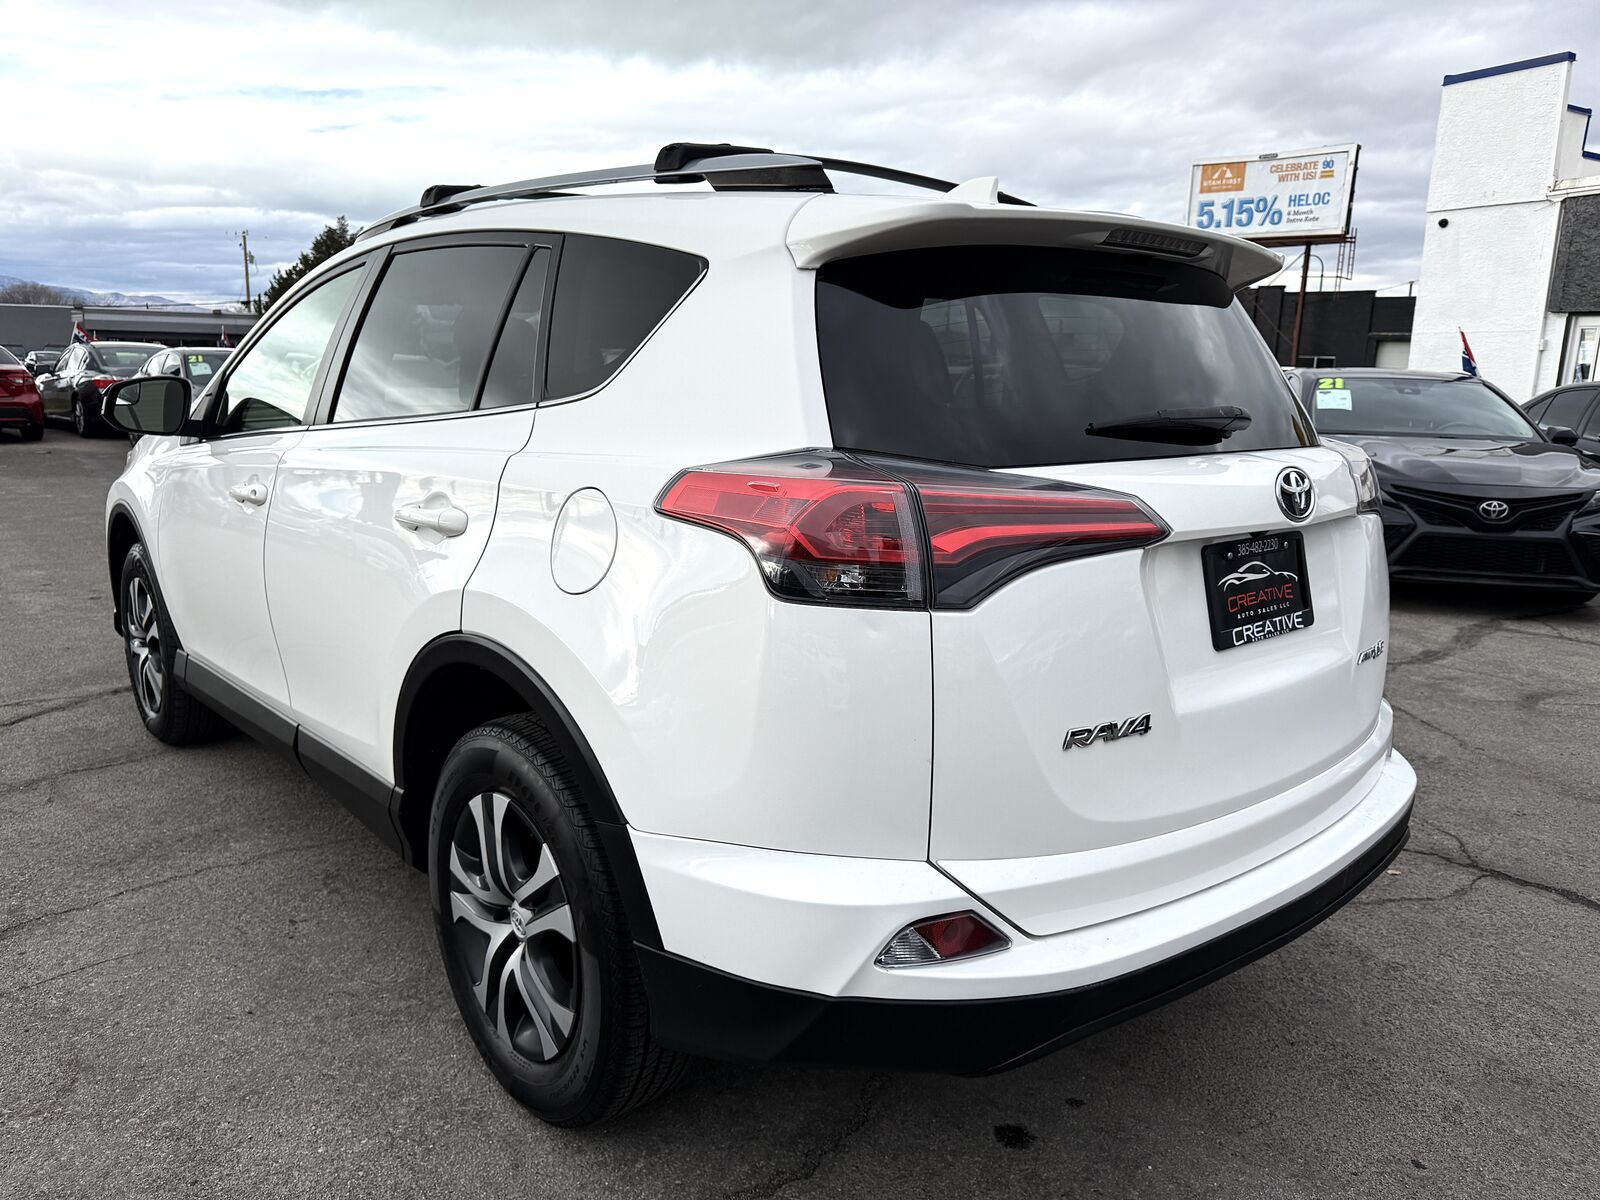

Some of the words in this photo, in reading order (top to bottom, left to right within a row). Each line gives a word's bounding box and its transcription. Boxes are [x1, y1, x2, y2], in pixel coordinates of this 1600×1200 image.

[1270, 160, 1319, 174] CELEBRATE
[1322, 160, 1334, 169] 90
[1278, 173, 1300, 182] WITH
[1302, 171, 1317, 181] US!
[1288, 192, 1331, 208] HELOC
[1196, 195, 1283, 229] 5.15%
[1318, 378, 1344, 389] 21
[1238, 538, 1278, 556] 385-482-2230
[1228, 584, 1294, 612] CREATIVE
[1238, 610, 1254, 620] AUTO
[1258, 604, 1278, 614] SALES
[1232, 611, 1304, 646] CREATIVE
[1062, 712, 1152, 750] RAV4
